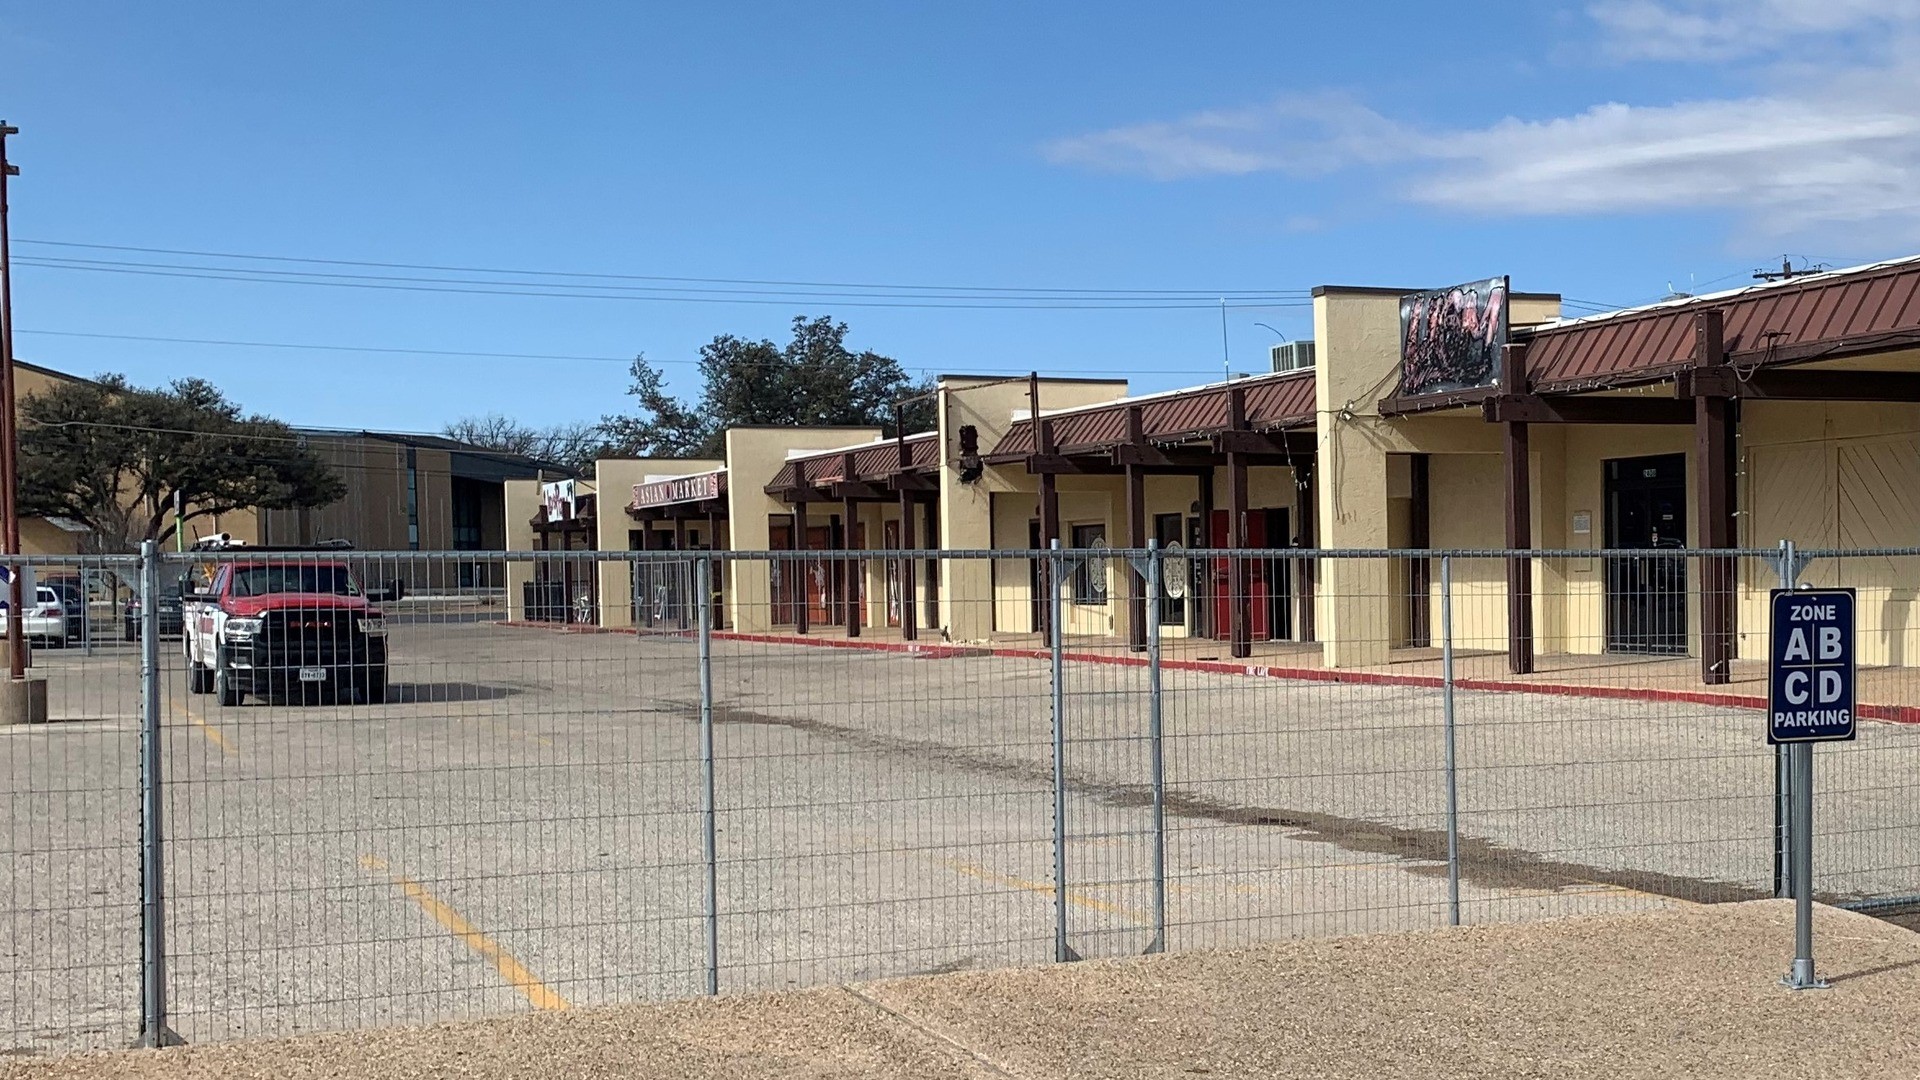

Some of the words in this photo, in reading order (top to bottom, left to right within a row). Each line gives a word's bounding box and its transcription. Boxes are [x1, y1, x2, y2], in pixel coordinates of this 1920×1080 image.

[640, 484, 665, 504] ASIAN
[672, 477, 708, 500] MARKET
[1790, 605, 1836, 621] ZONE
[1783, 628, 1810, 661] A
[1819, 627, 1842, 660] B
[1784, 671, 1809, 705] C
[1819, 670, 1842, 703] D
[1774, 709, 1850, 728] PARKING
